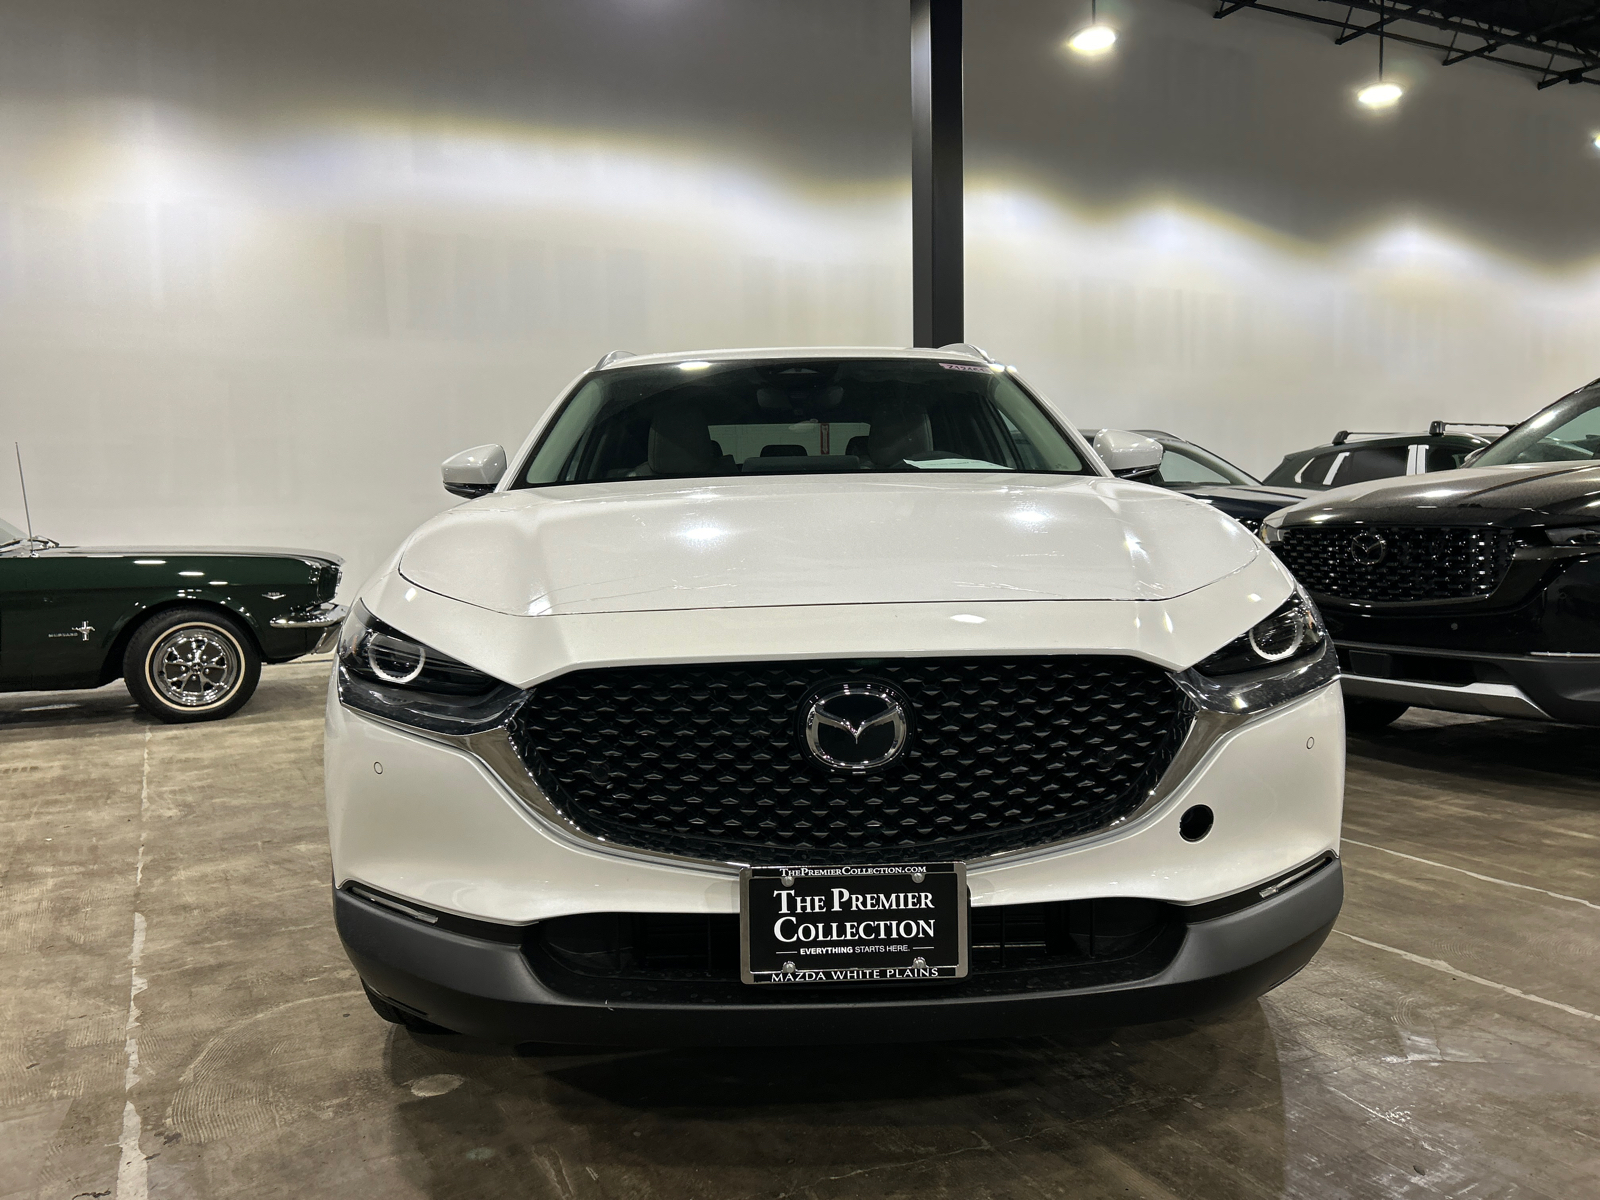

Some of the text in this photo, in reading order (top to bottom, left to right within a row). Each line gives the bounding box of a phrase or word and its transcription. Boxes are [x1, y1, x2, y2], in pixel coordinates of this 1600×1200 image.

[773, 887, 935, 914] THE PREMIER
[773, 916, 936, 943] COLLECTION
[800, 944, 910, 955] EVERYTHING STARTS HERE.
[771, 967, 939, 983] MAZDA WHITE PLAINS
